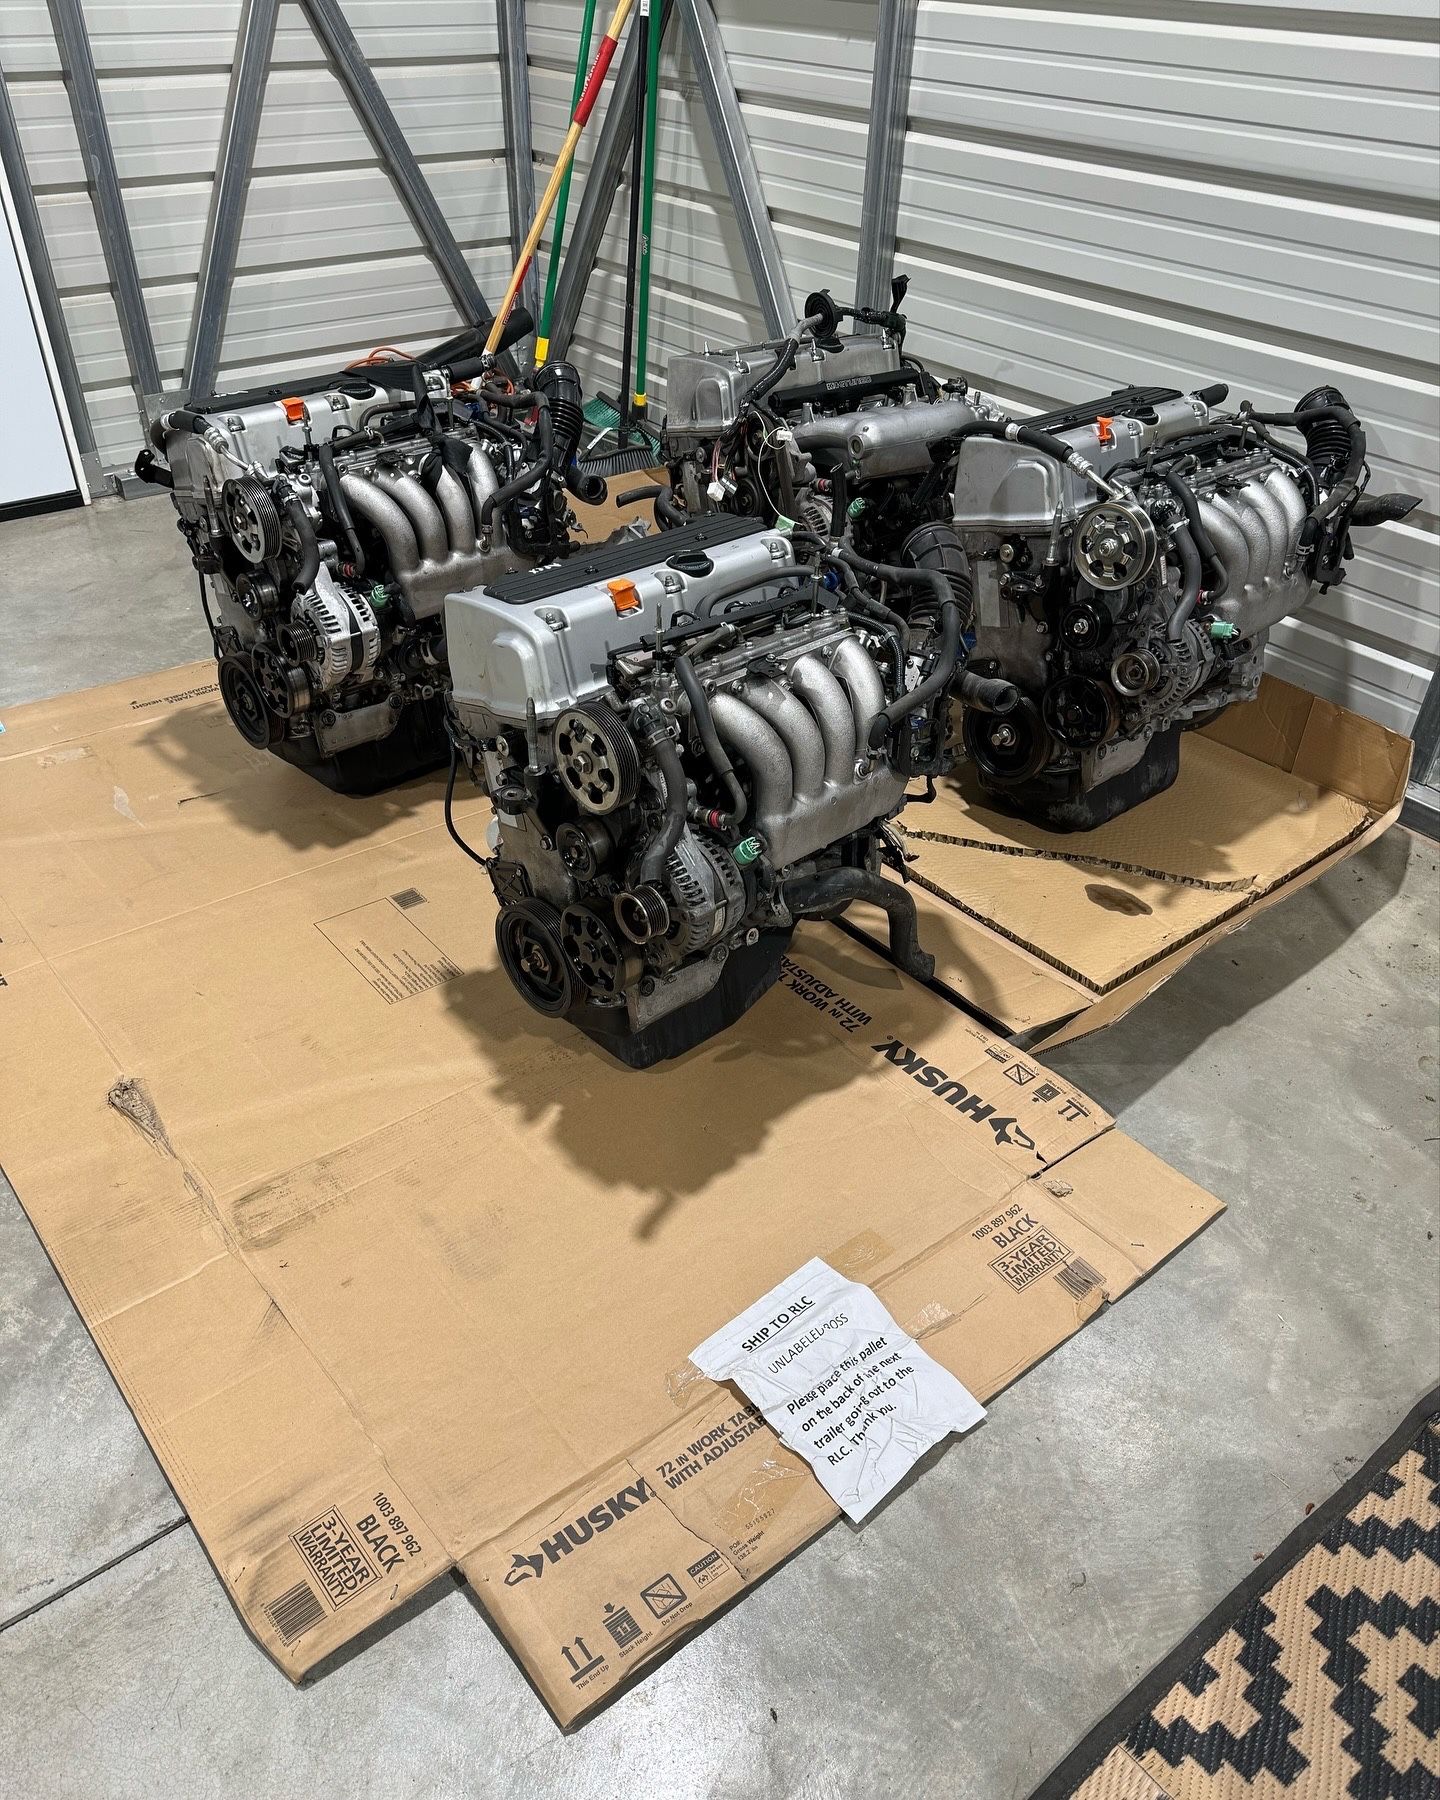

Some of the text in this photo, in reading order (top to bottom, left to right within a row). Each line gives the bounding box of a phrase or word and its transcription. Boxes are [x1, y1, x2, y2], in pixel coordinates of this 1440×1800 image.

[785, 977, 860, 1033] 72 IN WORK
[834, 997, 873, 1026] WITH
[972, 1204, 1023, 1240] 1003 897 962
[992, 1213, 1039, 1249] BLACK
[997, 1234, 1050, 1272] 3-YEAR
[1005, 1241, 1057, 1280] LIMITED
[1011, 1246, 1065, 1287] WARRANTY
[742, 1296, 813, 1352] SHIP TO RLC
[786, 1388, 819, 1414] Please
[858, 1337, 887, 1361] pallet
[801, 1417, 817, 1432] on
[816, 1406, 833, 1420] the
[829, 1385, 855, 1409] back
[853, 1373, 866, 1386] of
[879, 1353, 902, 1368] next
[813, 1422, 845, 1449] trailer
[882, 1378, 897, 1390] to
[896, 1366, 914, 1380] the
[655, 1402, 762, 1478] 72 IN WORK TABL
[664, 1413, 767, 1490] WITH ADJUSTAB
[827, 1446, 853, 1466] RLC.
[356, 1514, 404, 1574] BLACK
[372, 1492, 422, 1557] 1003 897 962
[747, 1530, 765, 1545] Weight
[299, 1531, 348, 1598] WARRANTY
[310, 1524, 358, 1590] LIMITED
[322, 1516, 370, 1583] 3-YEAR
[690, 1553, 717, 1574] CAUTION
[615, 1621, 631, 1638] 11
[634, 1631, 654, 1647] Height
[576, 1679, 590, 1690] This
[588, 1669, 601, 1681] End
